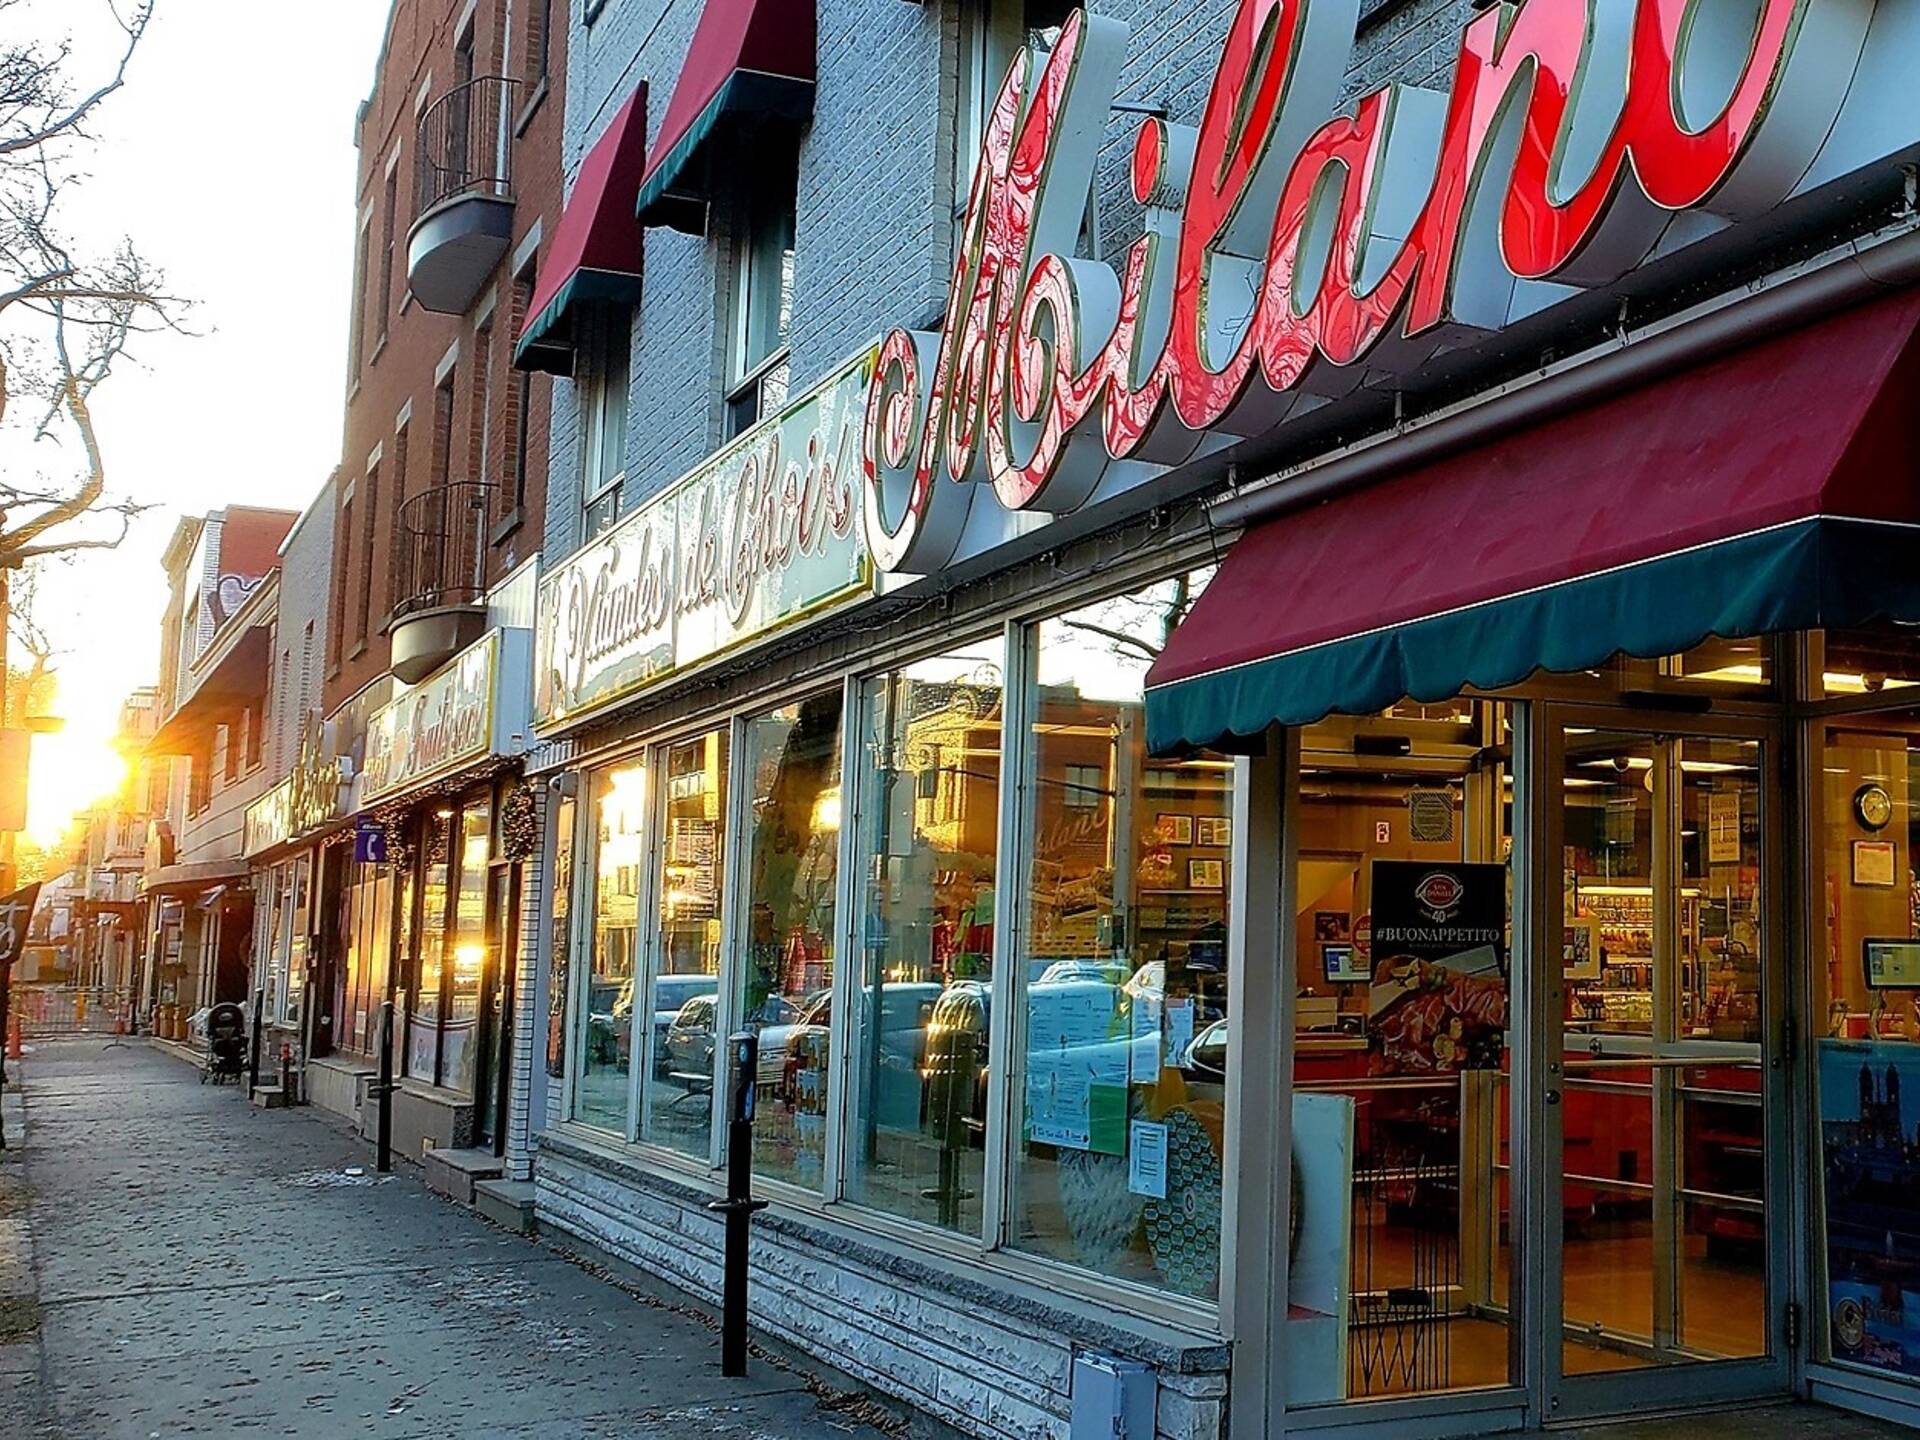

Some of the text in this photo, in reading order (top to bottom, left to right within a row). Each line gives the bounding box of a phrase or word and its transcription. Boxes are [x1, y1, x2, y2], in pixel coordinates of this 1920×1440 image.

[864, 0, 1806, 574] Milano
[676, 482, 721, 615] de
[724, 424, 853, 629] Choix
[1376, 927, 1500, 942] #BUONAPPETITO
[1431, 910, 1446, 923] 40
